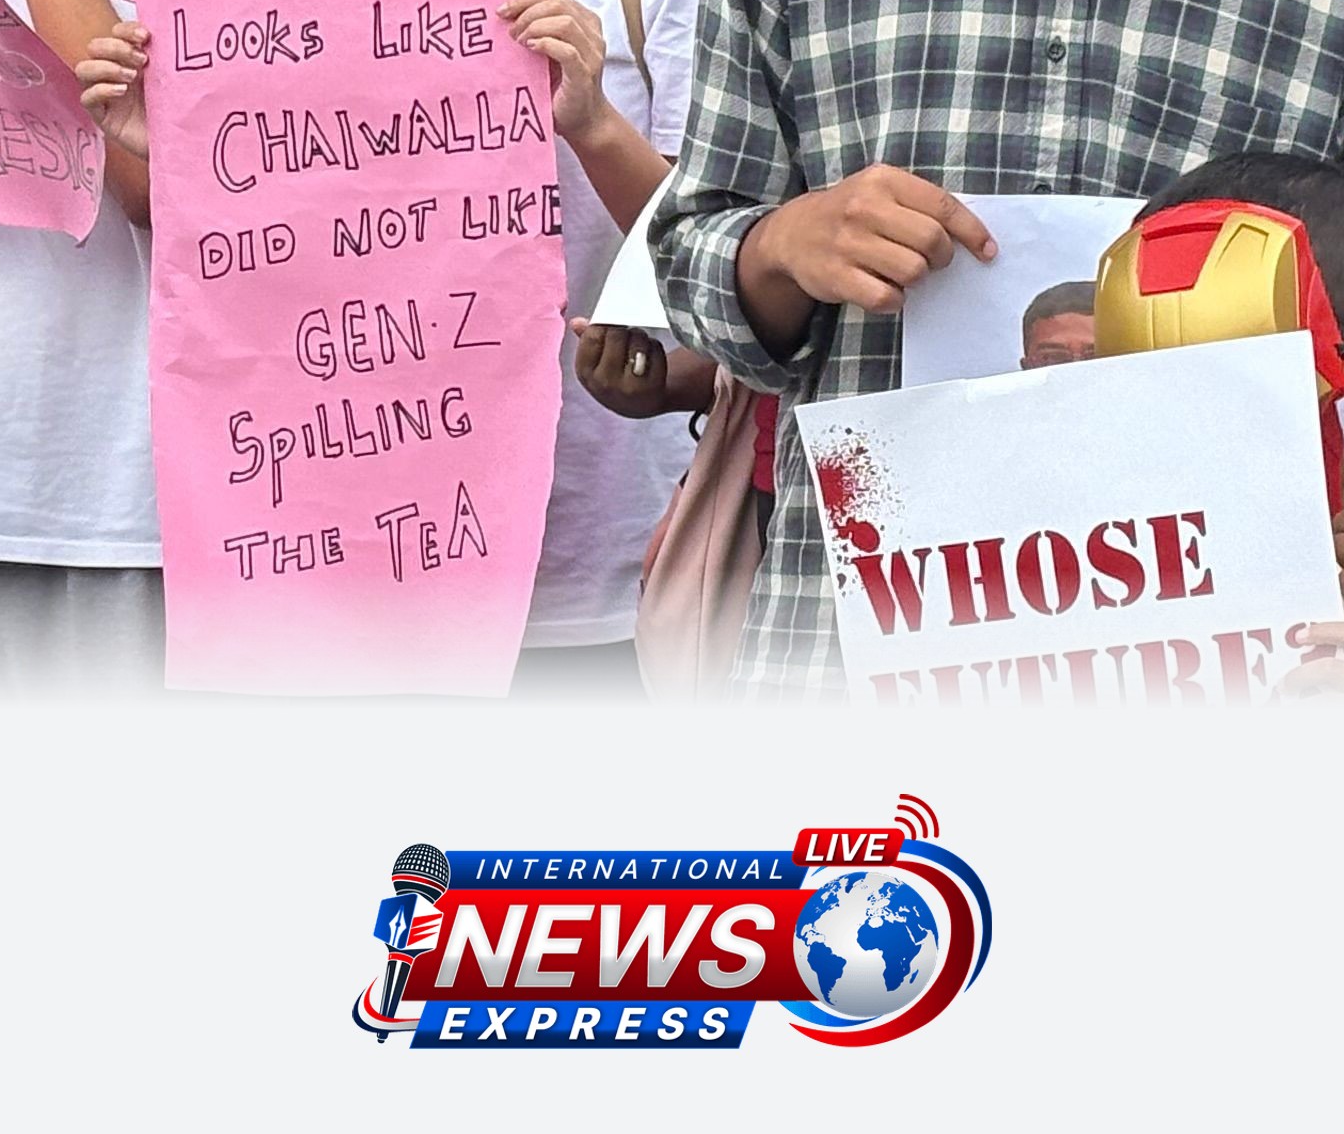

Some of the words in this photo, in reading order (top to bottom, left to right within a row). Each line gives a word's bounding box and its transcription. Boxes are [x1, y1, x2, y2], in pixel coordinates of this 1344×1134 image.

[212, 86, 546, 193] CHAIWALLA
[199, 223, 296, 280] DID
[333, 198, 437, 258] NOT
[462, 184, 562, 240] LIKE
[224, 527, 344, 580] THE
[853, 511, 1214, 635] WHOSE
